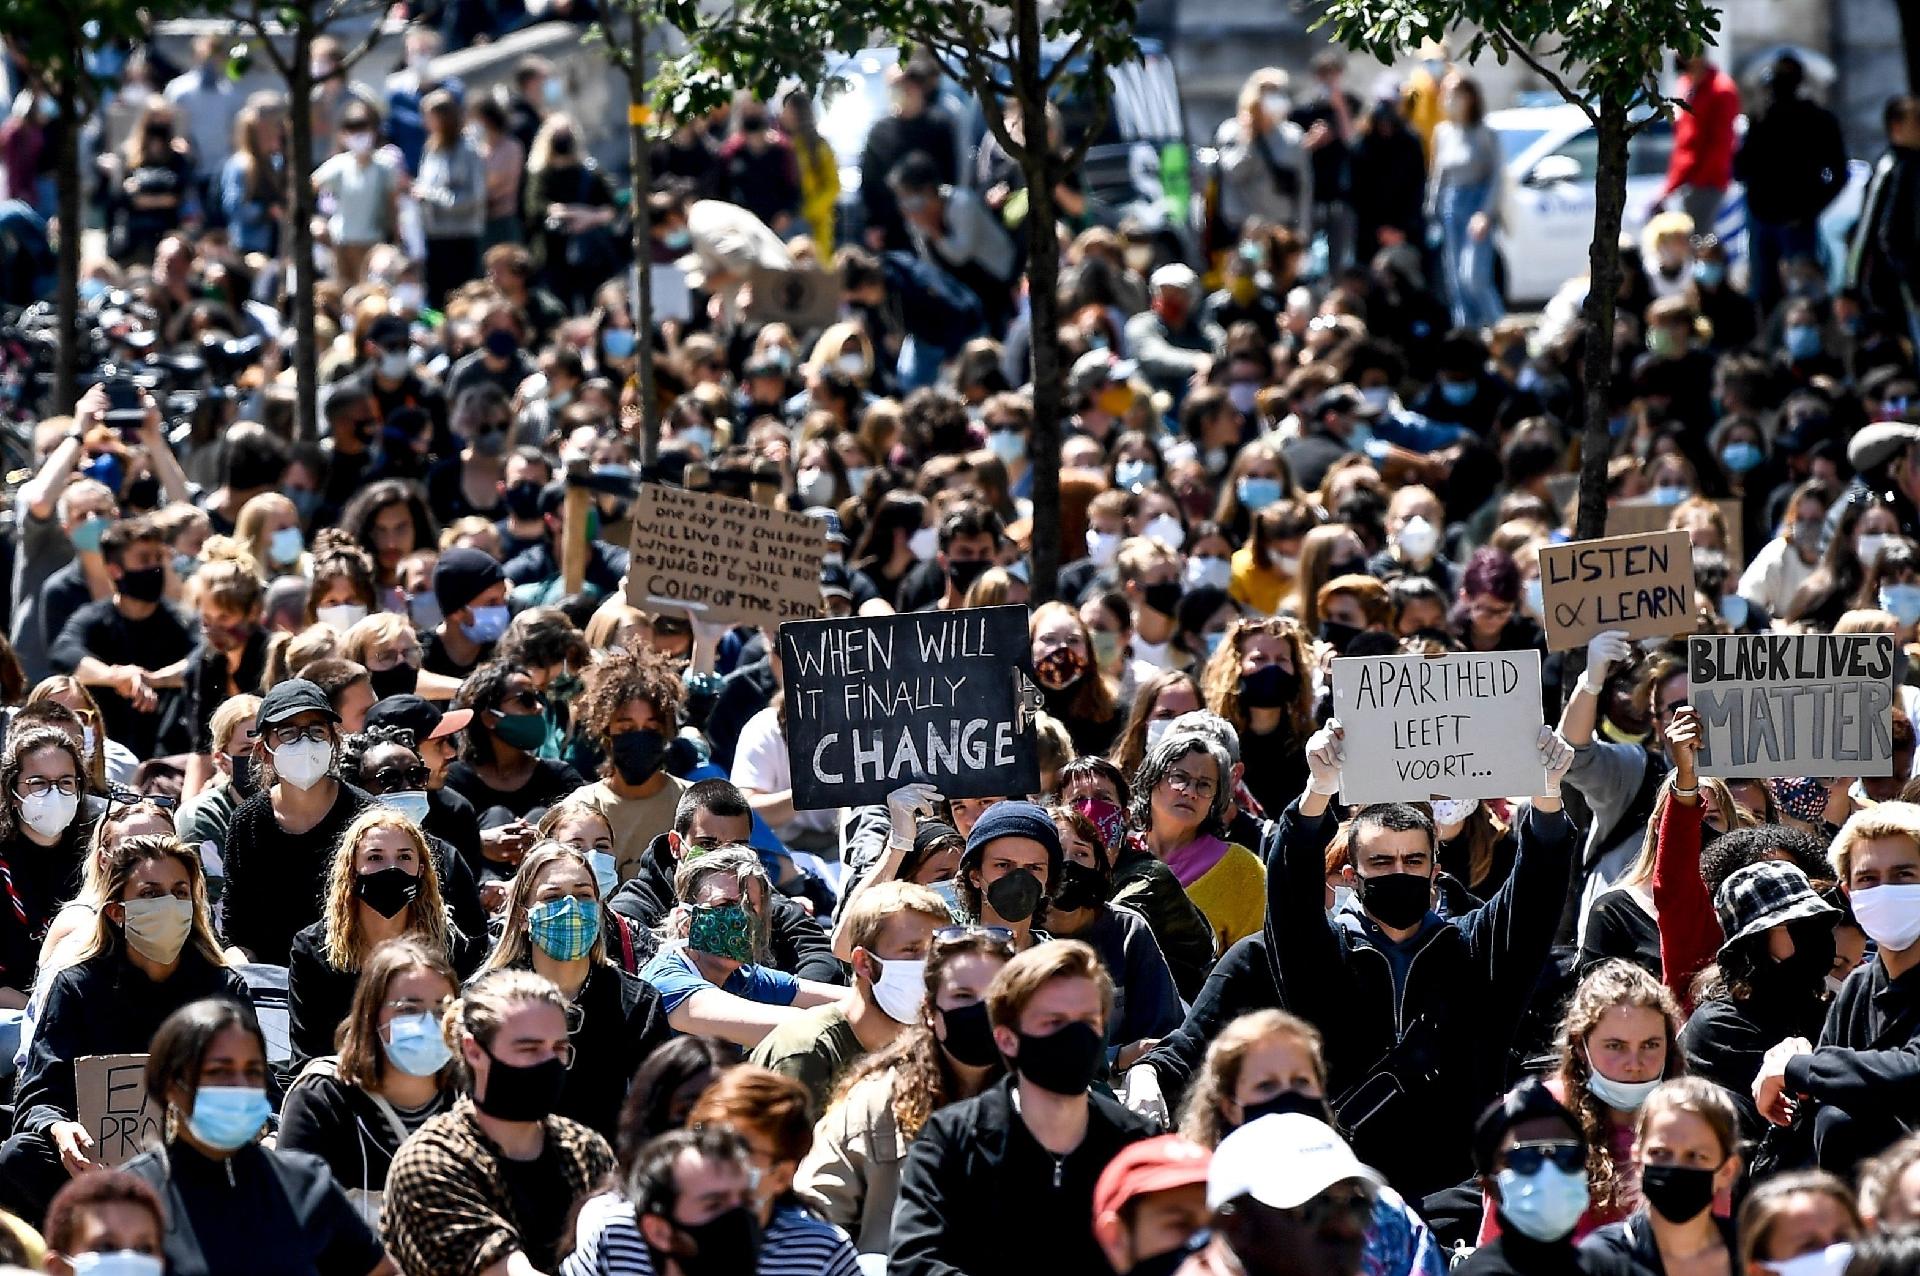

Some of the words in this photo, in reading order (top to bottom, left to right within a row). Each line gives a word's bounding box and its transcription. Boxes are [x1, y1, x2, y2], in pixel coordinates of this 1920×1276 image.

[1597, 584, 1687, 624] LEARN
[785, 624, 894, 678] WHEN
[1691, 635, 1791, 684] BLACK
[1795, 635, 1893, 680] LIVES
[1356, 659, 1519, 710] APARTHEID
[1394, 714, 1472, 750] LEEFT
[1694, 681, 1893, 768] MATTER
[812, 718, 1016, 784] CHANGE
[1395, 752, 1493, 782] VOORT...
